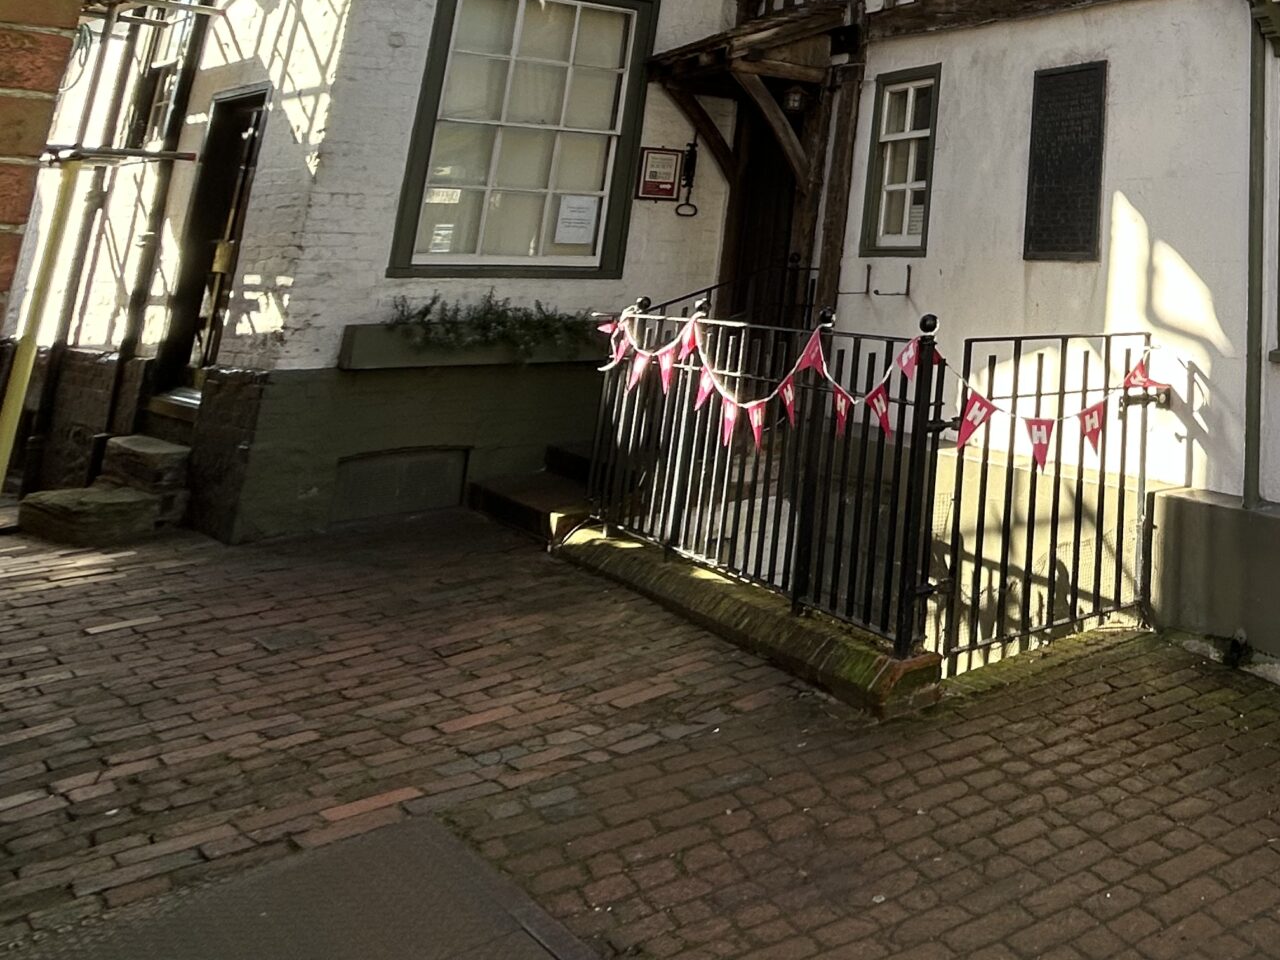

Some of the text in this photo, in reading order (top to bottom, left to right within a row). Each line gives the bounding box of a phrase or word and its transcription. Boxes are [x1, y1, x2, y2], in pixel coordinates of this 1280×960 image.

[836, 393, 847, 417] H
[966, 401, 988, 426] H
[1085, 411, 1101, 432] H
[1031, 424, 1048, 445] H
